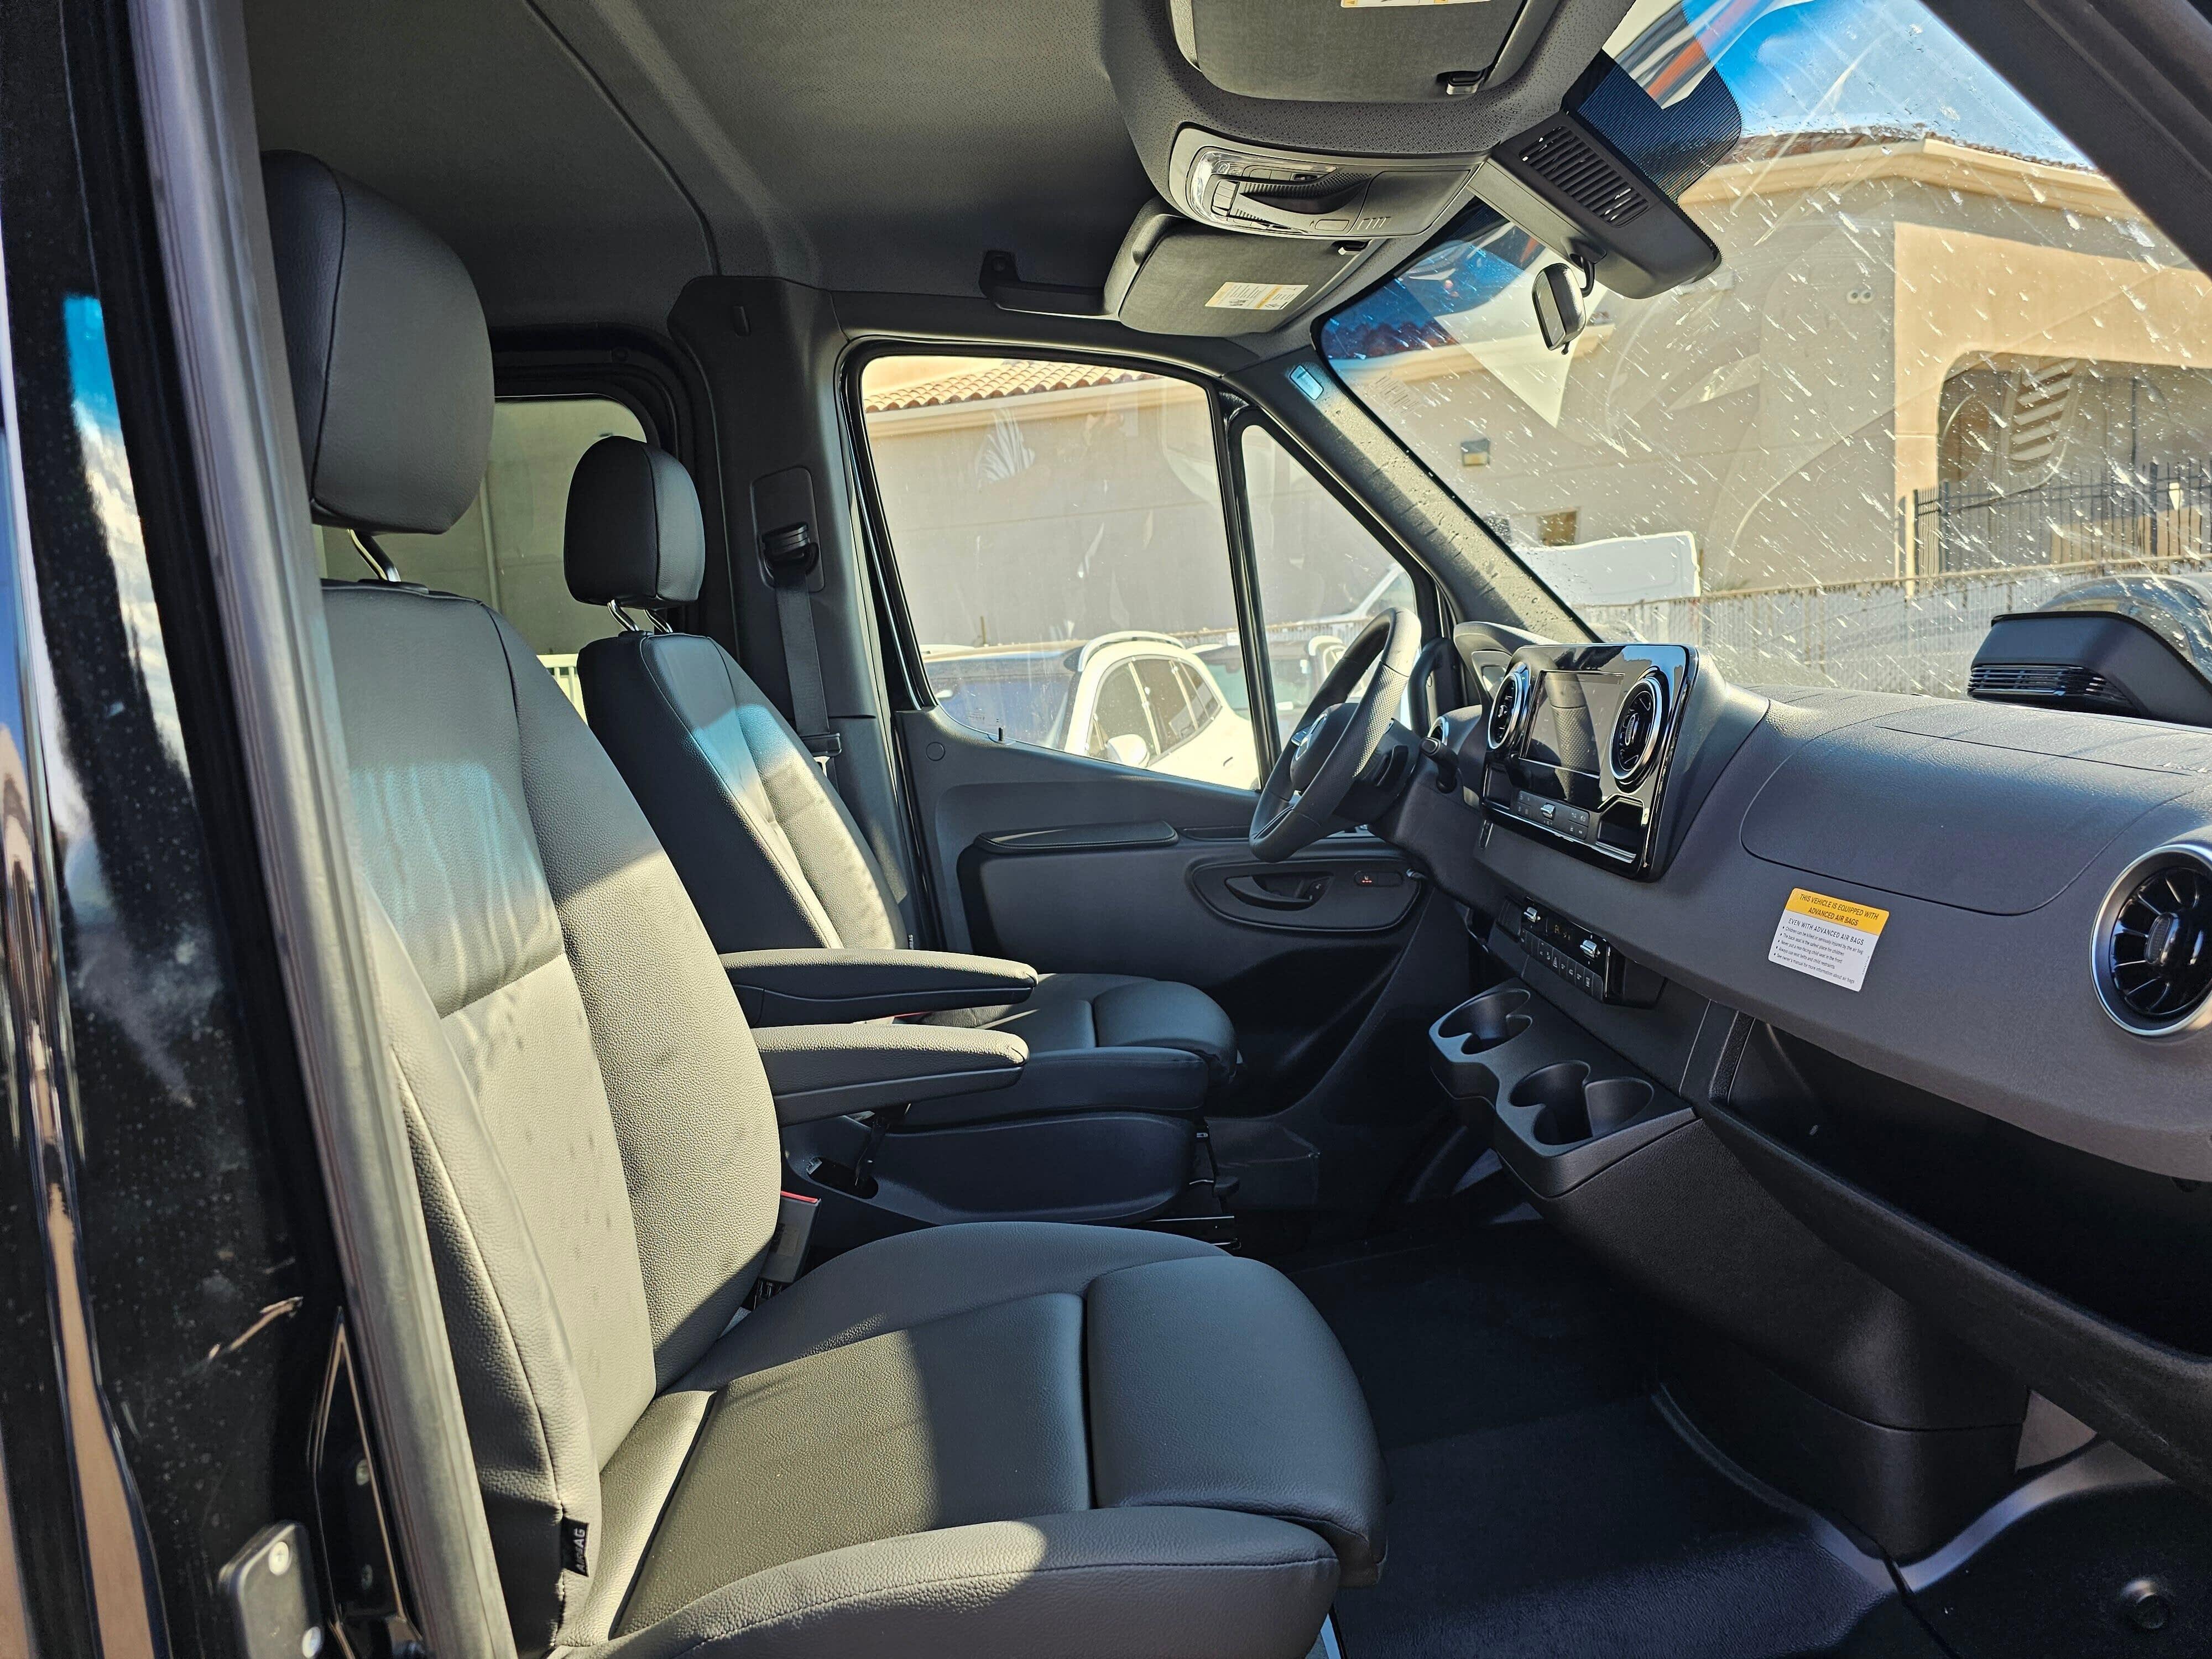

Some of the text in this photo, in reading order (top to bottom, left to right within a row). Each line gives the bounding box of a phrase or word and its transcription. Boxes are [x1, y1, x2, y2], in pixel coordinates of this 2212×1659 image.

[1800, 894, 1811, 902] THIS
[1811, 898, 1832, 907] VEHICLE
[1838, 904, 1864, 916] EQUIPPED
[1864, 910, 1879, 920] WITH
[1808, 907, 1835, 919] ADVANCED
[1844, 917, 1859, 926] BAGS
[1788, 918, 1801, 926] EVEN
[1801, 921, 1813, 930] WITH
[1814, 925, 1840, 938] ADVANCED
[1850, 936, 1864, 946] BAGS
[573, 1527, 586, 1573] AIRBAG
